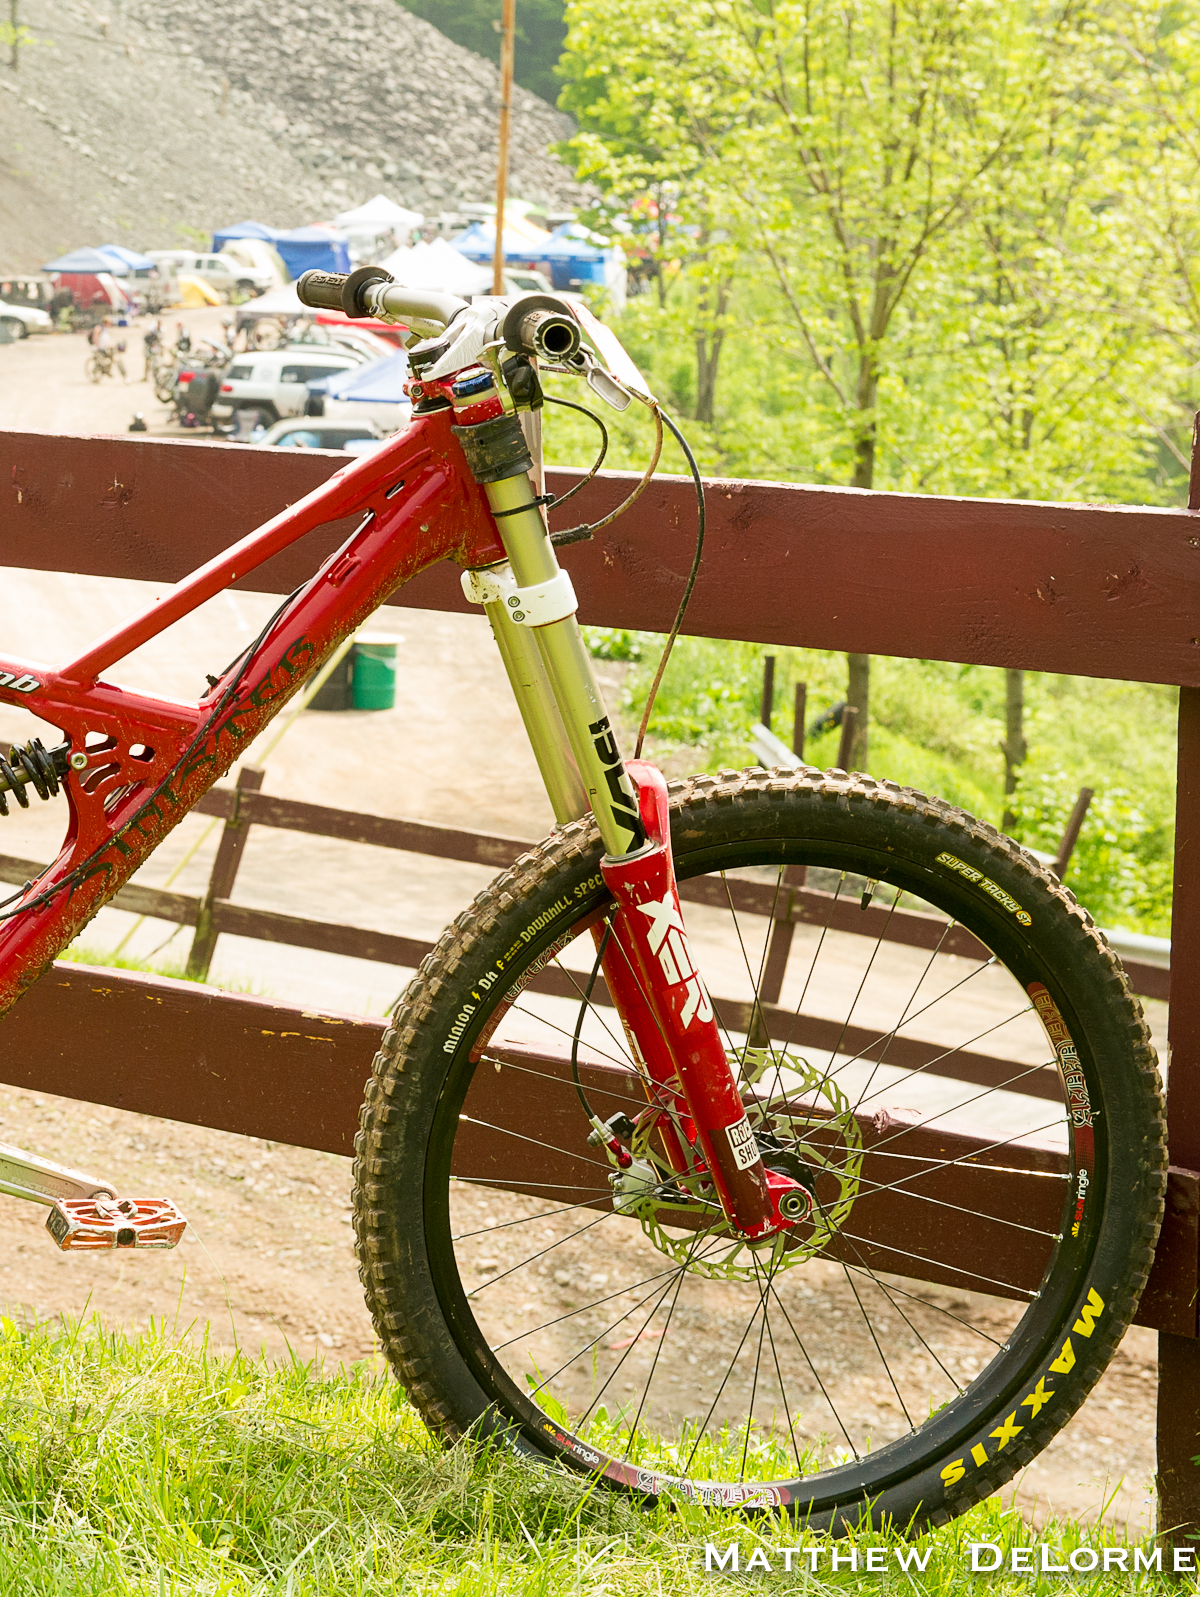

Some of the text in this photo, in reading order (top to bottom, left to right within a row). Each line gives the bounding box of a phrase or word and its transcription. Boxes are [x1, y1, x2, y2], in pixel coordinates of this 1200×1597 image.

[936, 852, 1031, 925] SUPER TACKY ST
[730, 1118, 752, 1146] ROC
[738, 1141, 758, 1165] SHO
[1074, 1168, 1090, 1222] SUNringle
[939, 1286, 1105, 1488] MAXXIS
